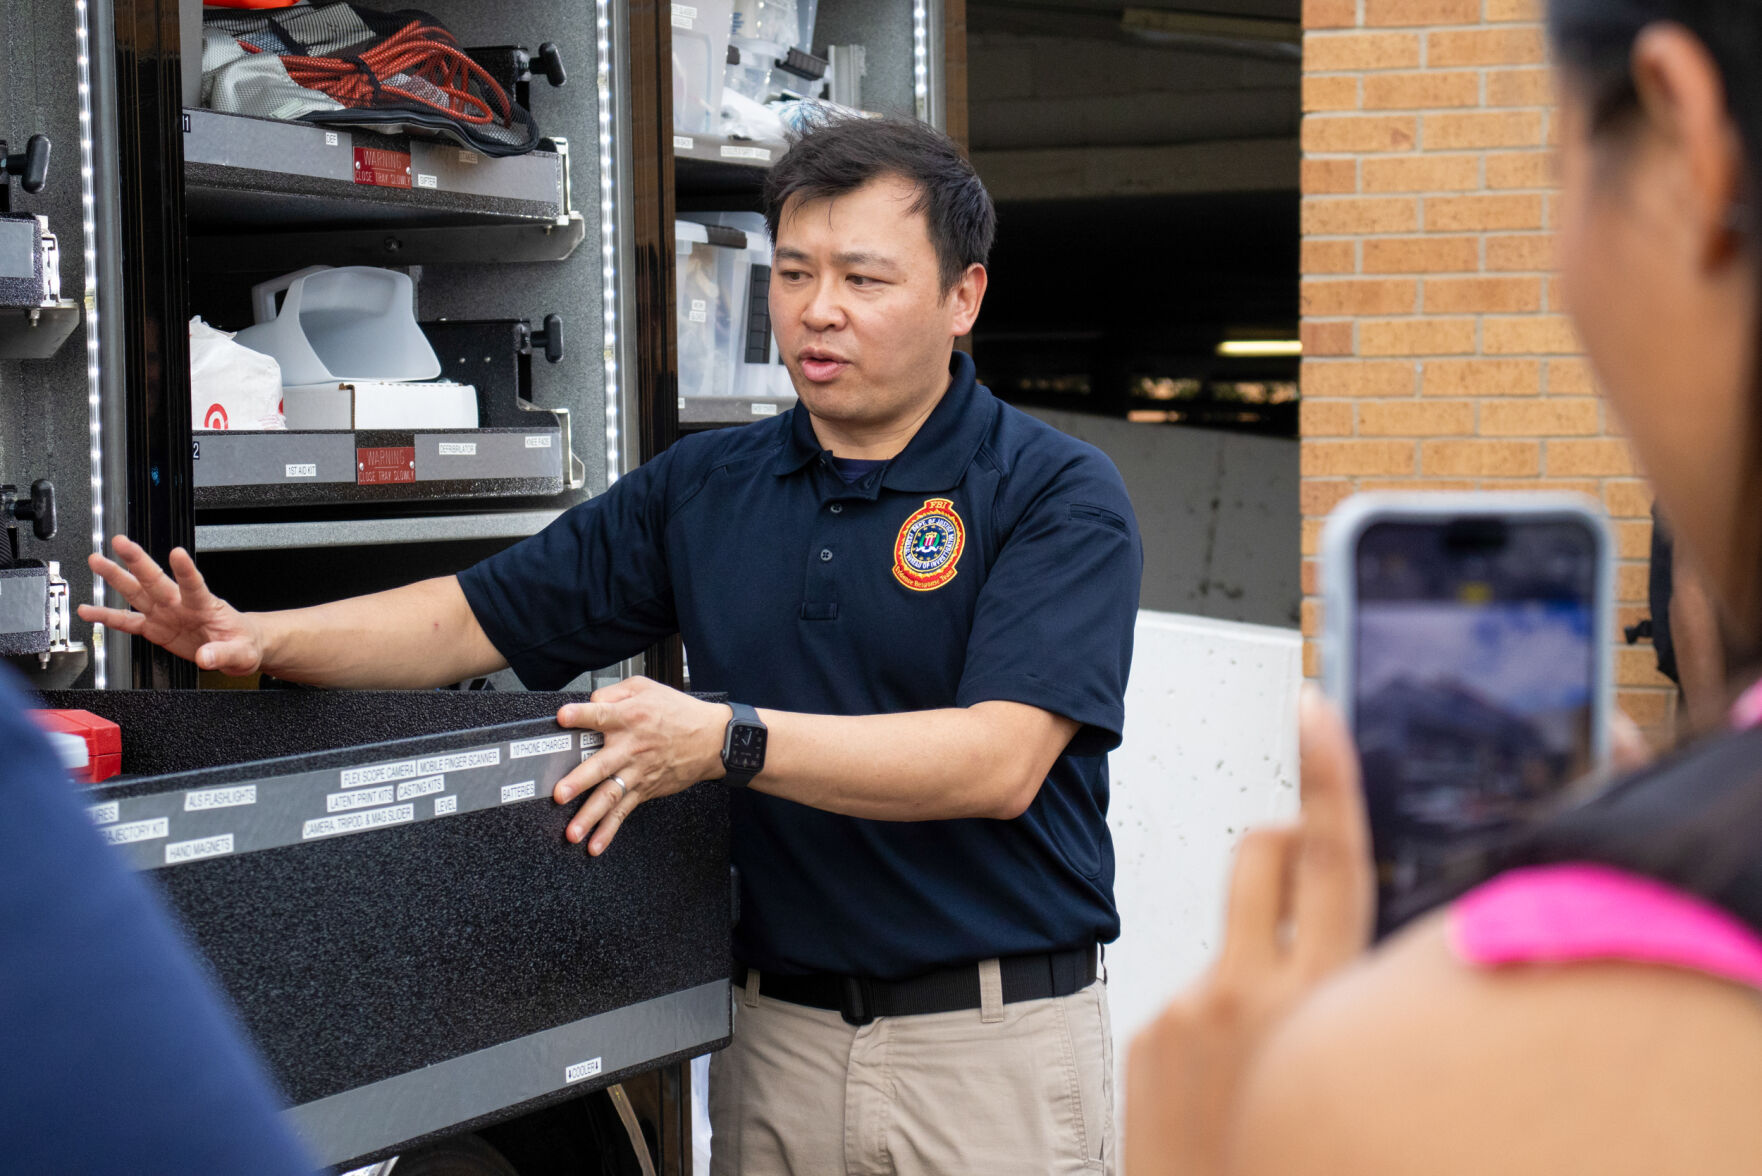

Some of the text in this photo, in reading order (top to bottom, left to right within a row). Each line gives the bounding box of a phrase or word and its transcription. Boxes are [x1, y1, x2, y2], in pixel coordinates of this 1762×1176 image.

[363, 150, 402, 169] WARNING
[355, 170, 411, 186] CLOSE TRAY SLOWLY
[367, 450, 405, 466] WARNING
[288, 465, 315, 476] 1ST AID KIT
[359, 469, 415, 483] CLOSE TRAY SLOWLY
[929, 501, 948, 509] FBI
[520, 741, 541, 755] PHONE
[541, 737, 569, 753] CHARGER
[420, 751, 497, 773] MOBILE FINGER SCANNER
[343, 763, 414, 785] FLEX SCOPE CAMERA
[204, 788, 255, 806] FLASHLIGHTS
[399, 778, 442, 798] CASTING KITS
[503, 783, 535, 801] BATTERIES
[330, 788, 393, 810] LATENT PRINT KITS
[436, 799, 456, 813] LEVEL
[372, 810, 387, 825] MAG
[388, 807, 411, 822] SLIDER
[152, 821, 165, 837] KIT
[169, 837, 231, 860] HAND MAGNETS
[572, 1061, 595, 1079] COOLER
